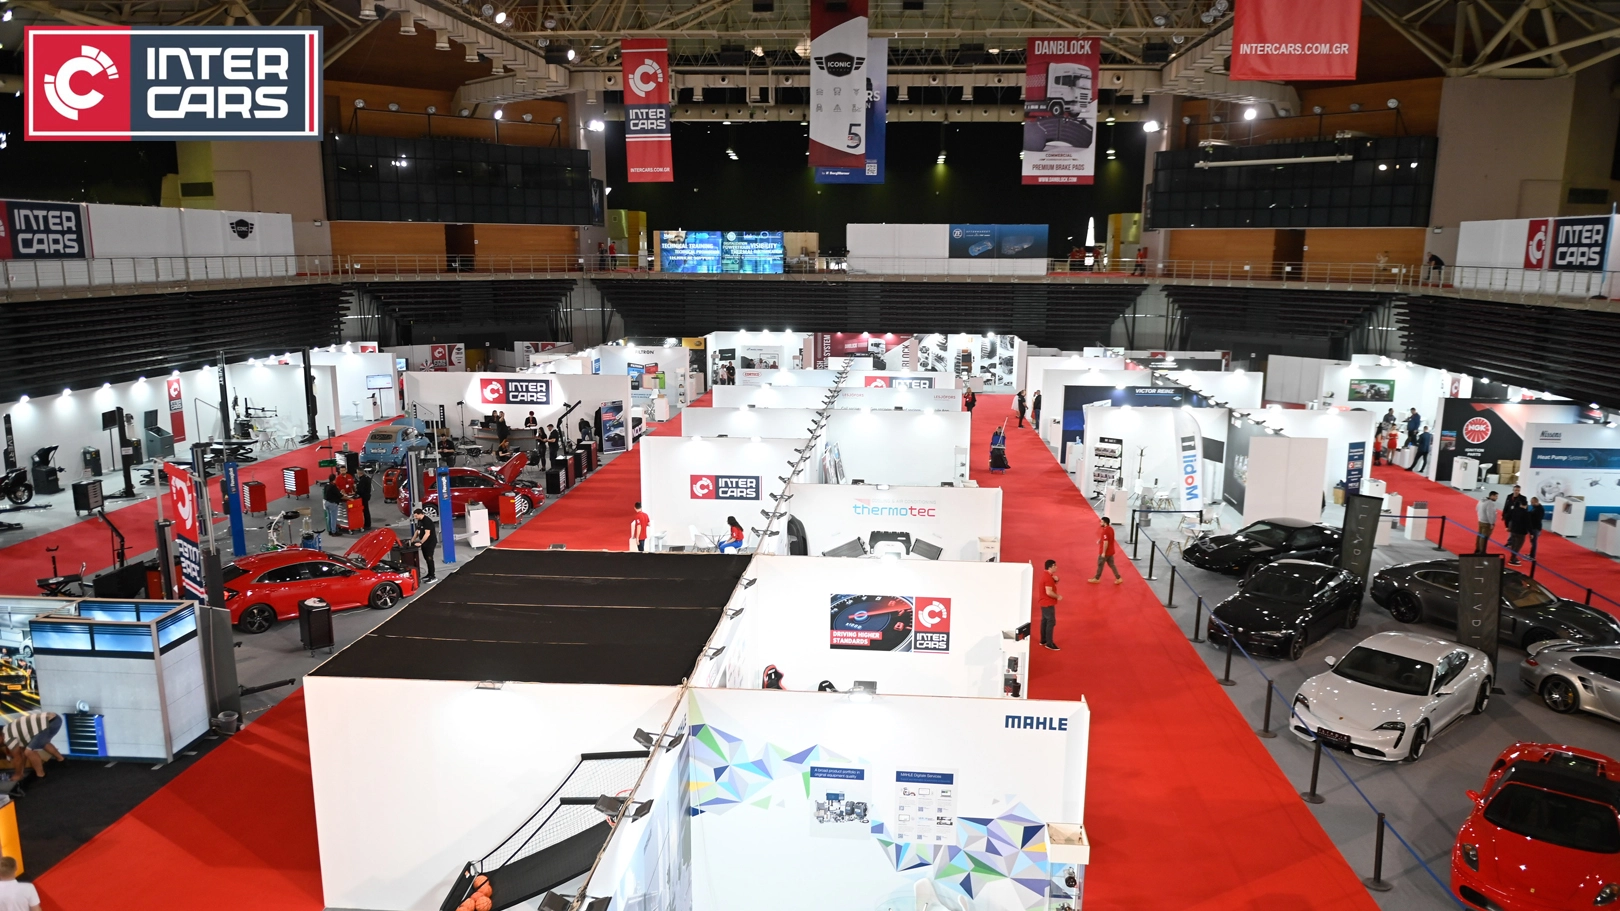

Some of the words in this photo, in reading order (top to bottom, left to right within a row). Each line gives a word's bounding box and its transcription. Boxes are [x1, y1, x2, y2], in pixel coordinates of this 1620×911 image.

[1034, 40, 1092, 55] DANBLOCK
[1239, 43, 1349, 55] INTERCARS.COM.GR
[629, 109, 666, 119] INTER
[630, 120, 666, 130] CARS
[847, 124, 861, 149] 5
[14, 209, 76, 231] INTER
[1557, 224, 1604, 244] INTER
[18, 233, 79, 254] CARS
[1555, 247, 1601, 266] CARS
[508, 382, 546, 392] INTER
[509, 392, 547, 402] CARS
[718, 478, 756, 488] INTER
[718, 488, 756, 498] CARS
[853, 504, 936, 517] thermotec
[916, 633, 947, 641] INTER
[916, 640, 947, 649] CARS
[1005, 715, 1068, 731] MAHLE
